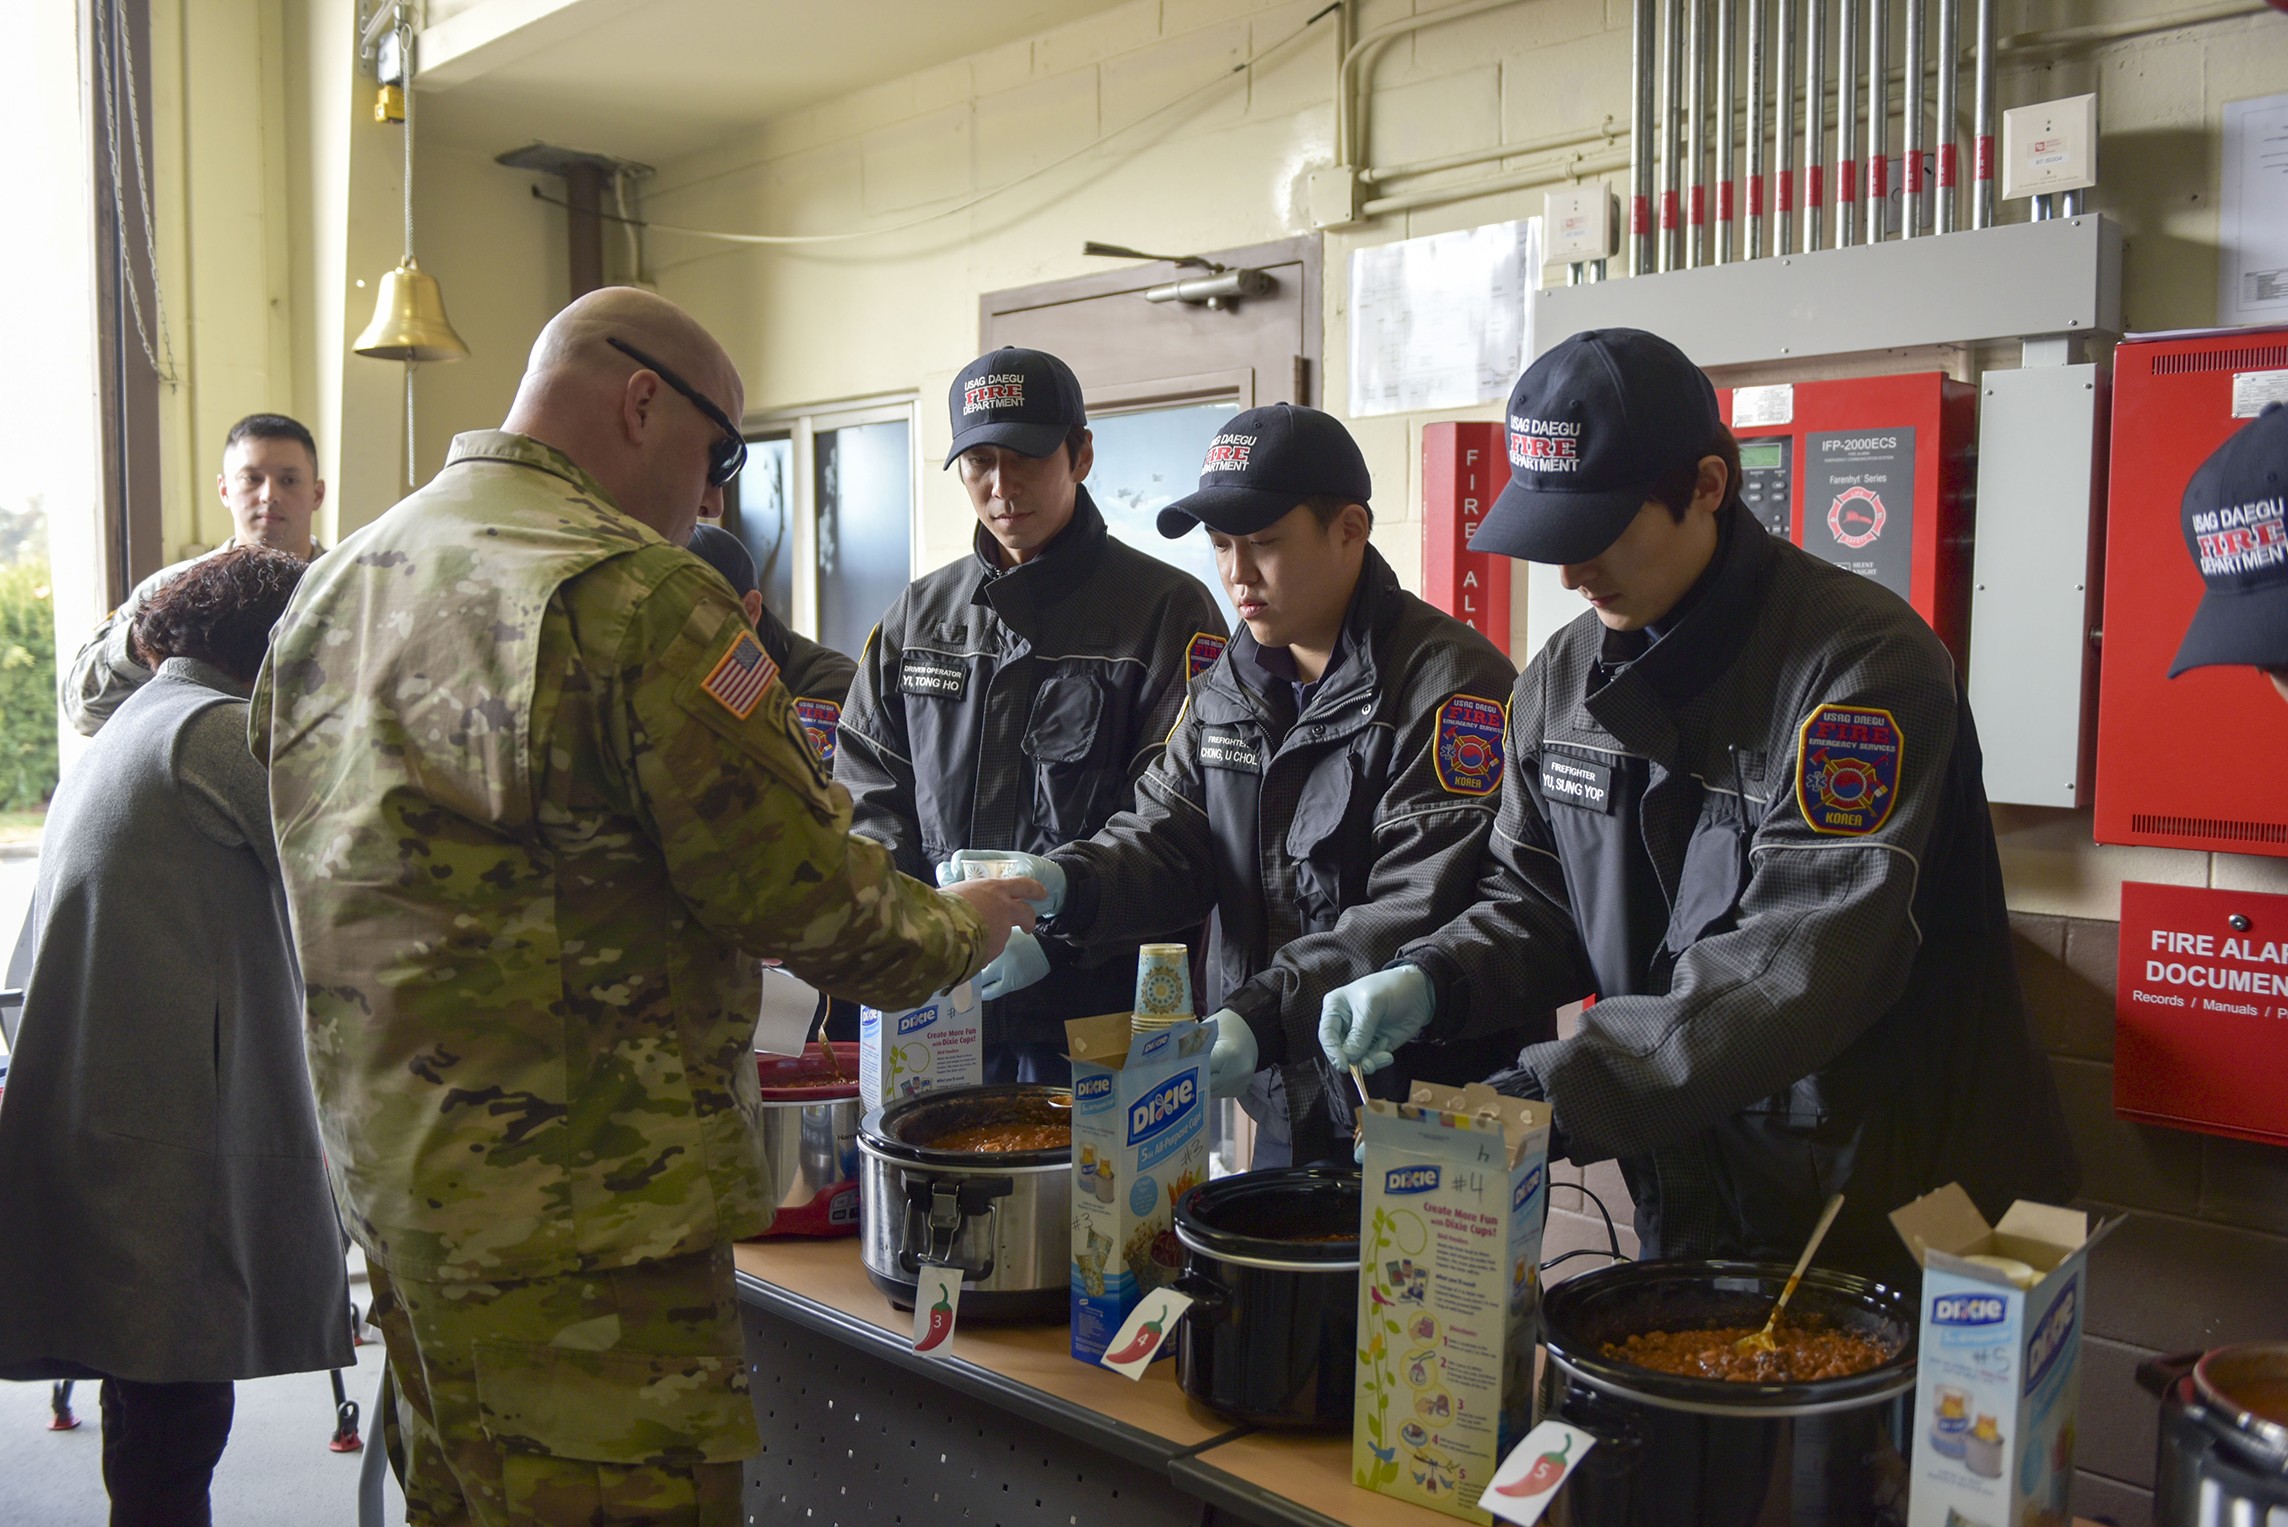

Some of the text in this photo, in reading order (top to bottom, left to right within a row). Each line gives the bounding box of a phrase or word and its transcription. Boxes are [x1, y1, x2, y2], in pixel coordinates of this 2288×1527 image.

[964, 374, 1024, 391] USAG DAEGU
[965, 384, 1022, 406] FIRE
[963, 398, 1025, 416] DEPARTMENT
[1510, 414, 1581, 436] USAG DAEGU
[1221, 434, 1257, 446] DAEGU
[1511, 432, 1576, 458] FIRE
[1822, 436, 1897, 452] IFP-2000ECS
[1509, 450, 1580, 472] DEPARTMENT
[1864, 473, 1887, 483] Series
[2192, 496, 2284, 533] USAG DAEGU
[2196, 518, 2288, 559] FIRE
[2200, 543, 2288, 576] DEPARTMEN
[904, 666, 962, 678] DRIVER OPERATOR
[915, 676, 941, 688] TONG
[942, 680, 959, 691] HO
[1453, 699, 1497, 714] USAG DAEGU
[1448, 706, 1501, 727] FIRE
[1823, 712, 1885, 726] USAG DAEGU
[1442, 718, 1504, 734] EMERGENCY SERVICES
[1816, 721, 1891, 744] FIRE
[1809, 738, 1896, 753] EMERGENCY SERVICES
[1200, 747, 1258, 766] CHONG, U CHOL
[1551, 761, 1596, 782] FIREFIGHTER
[1454, 776, 1482, 788] KOREA
[1543, 773, 1604, 802] YU, SUNG YOP
[1825, 812, 1863, 826] KOREA
[2151, 929, 2214, 957] FIRE
[2133, 990, 2185, 1007] Records
[2203, 999, 2258, 1016] Manuals
[927, 1031, 947, 1039] Create
[948, 1029, 964, 1037] More
[942, 1037, 959, 1046] Dixie
[959, 1035, 976, 1045] Cups!
[1181, 1139, 1204, 1167] #3
[1451, 1171, 1484, 1203] #4
[1072, 1212, 1093, 1231] #3
[1423, 1201, 1499, 1225] Create More Fun
[1445, 1217, 1468, 1232] Dixie
[1470, 1222, 1497, 1238] Cups!
[933, 1314, 942, 1328] 3
[1137, 1332, 1150, 1347] 4
[1443, 1335, 1448, 1347] 1
[1440, 1356, 1447, 1369] 2
[1457, 1398, 1464, 1410] 3
[1431, 1433, 1439, 1445] 4
[1458, 1468, 1466, 1480] 5
[1534, 1462, 1551, 1480] 5
